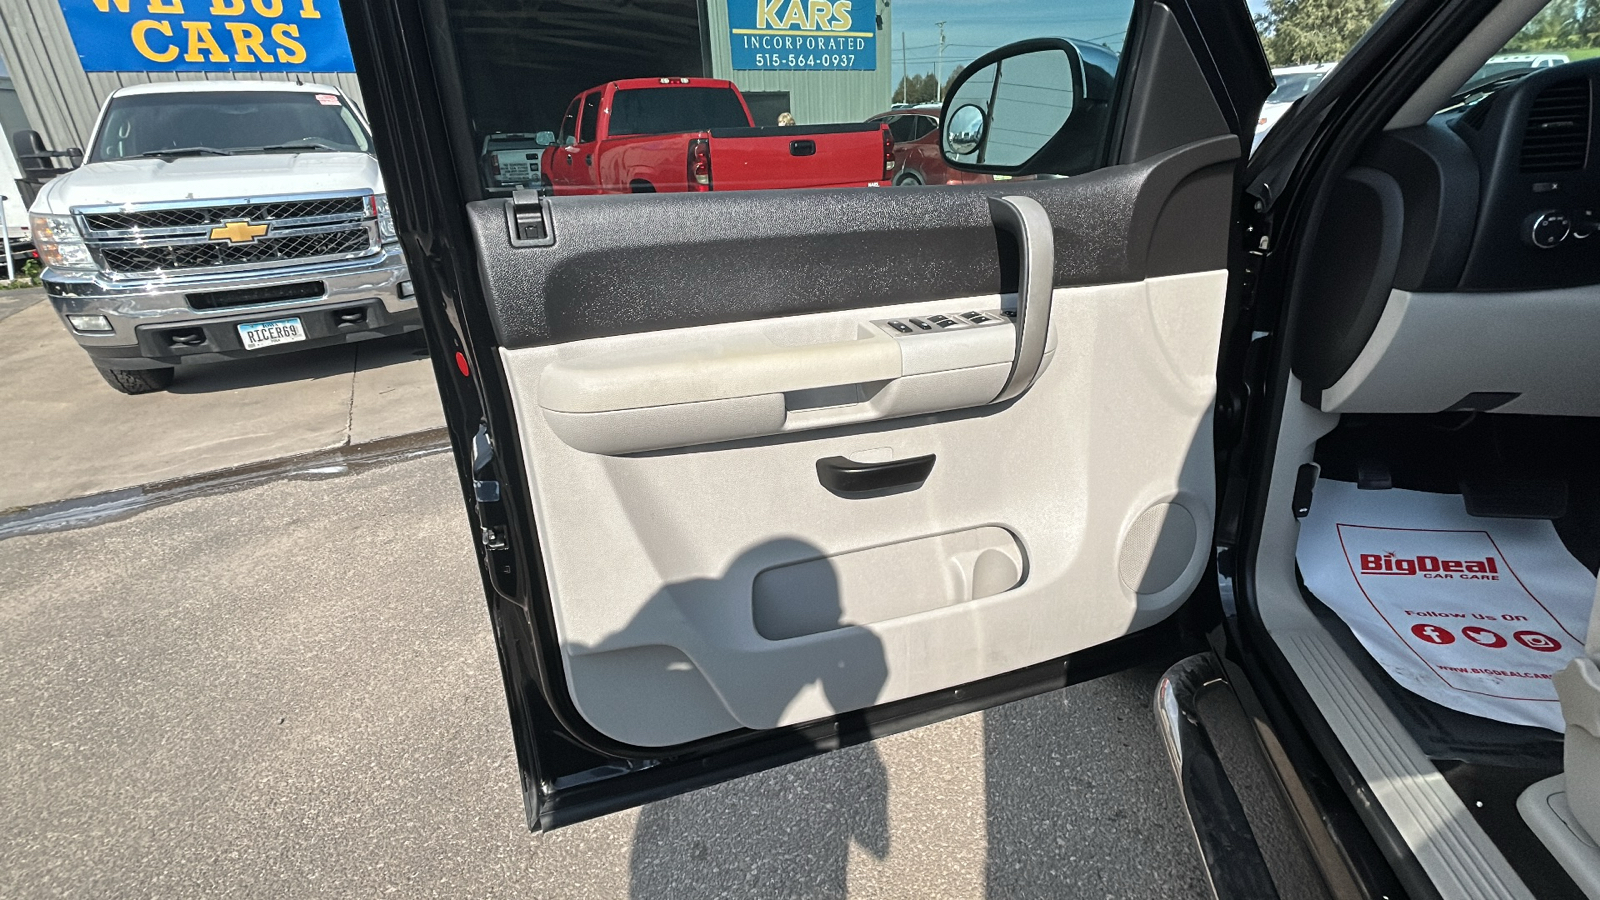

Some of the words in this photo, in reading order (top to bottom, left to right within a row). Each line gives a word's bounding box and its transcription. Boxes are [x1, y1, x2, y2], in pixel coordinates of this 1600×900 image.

[757, 0, 852, 31] KARS
[131, 20, 307, 63] CARS
[743, 36, 865, 50] INCORPORATED
[756, 54, 855, 67] 515-564-0937
[247, 325, 297, 343] RICER69
[1360, 554, 1498, 576] BigDeal
[1404, 610, 1466, 618] Follow
[1471, 613, 1497, 621] Us
[1501, 614, 1528, 622] On
